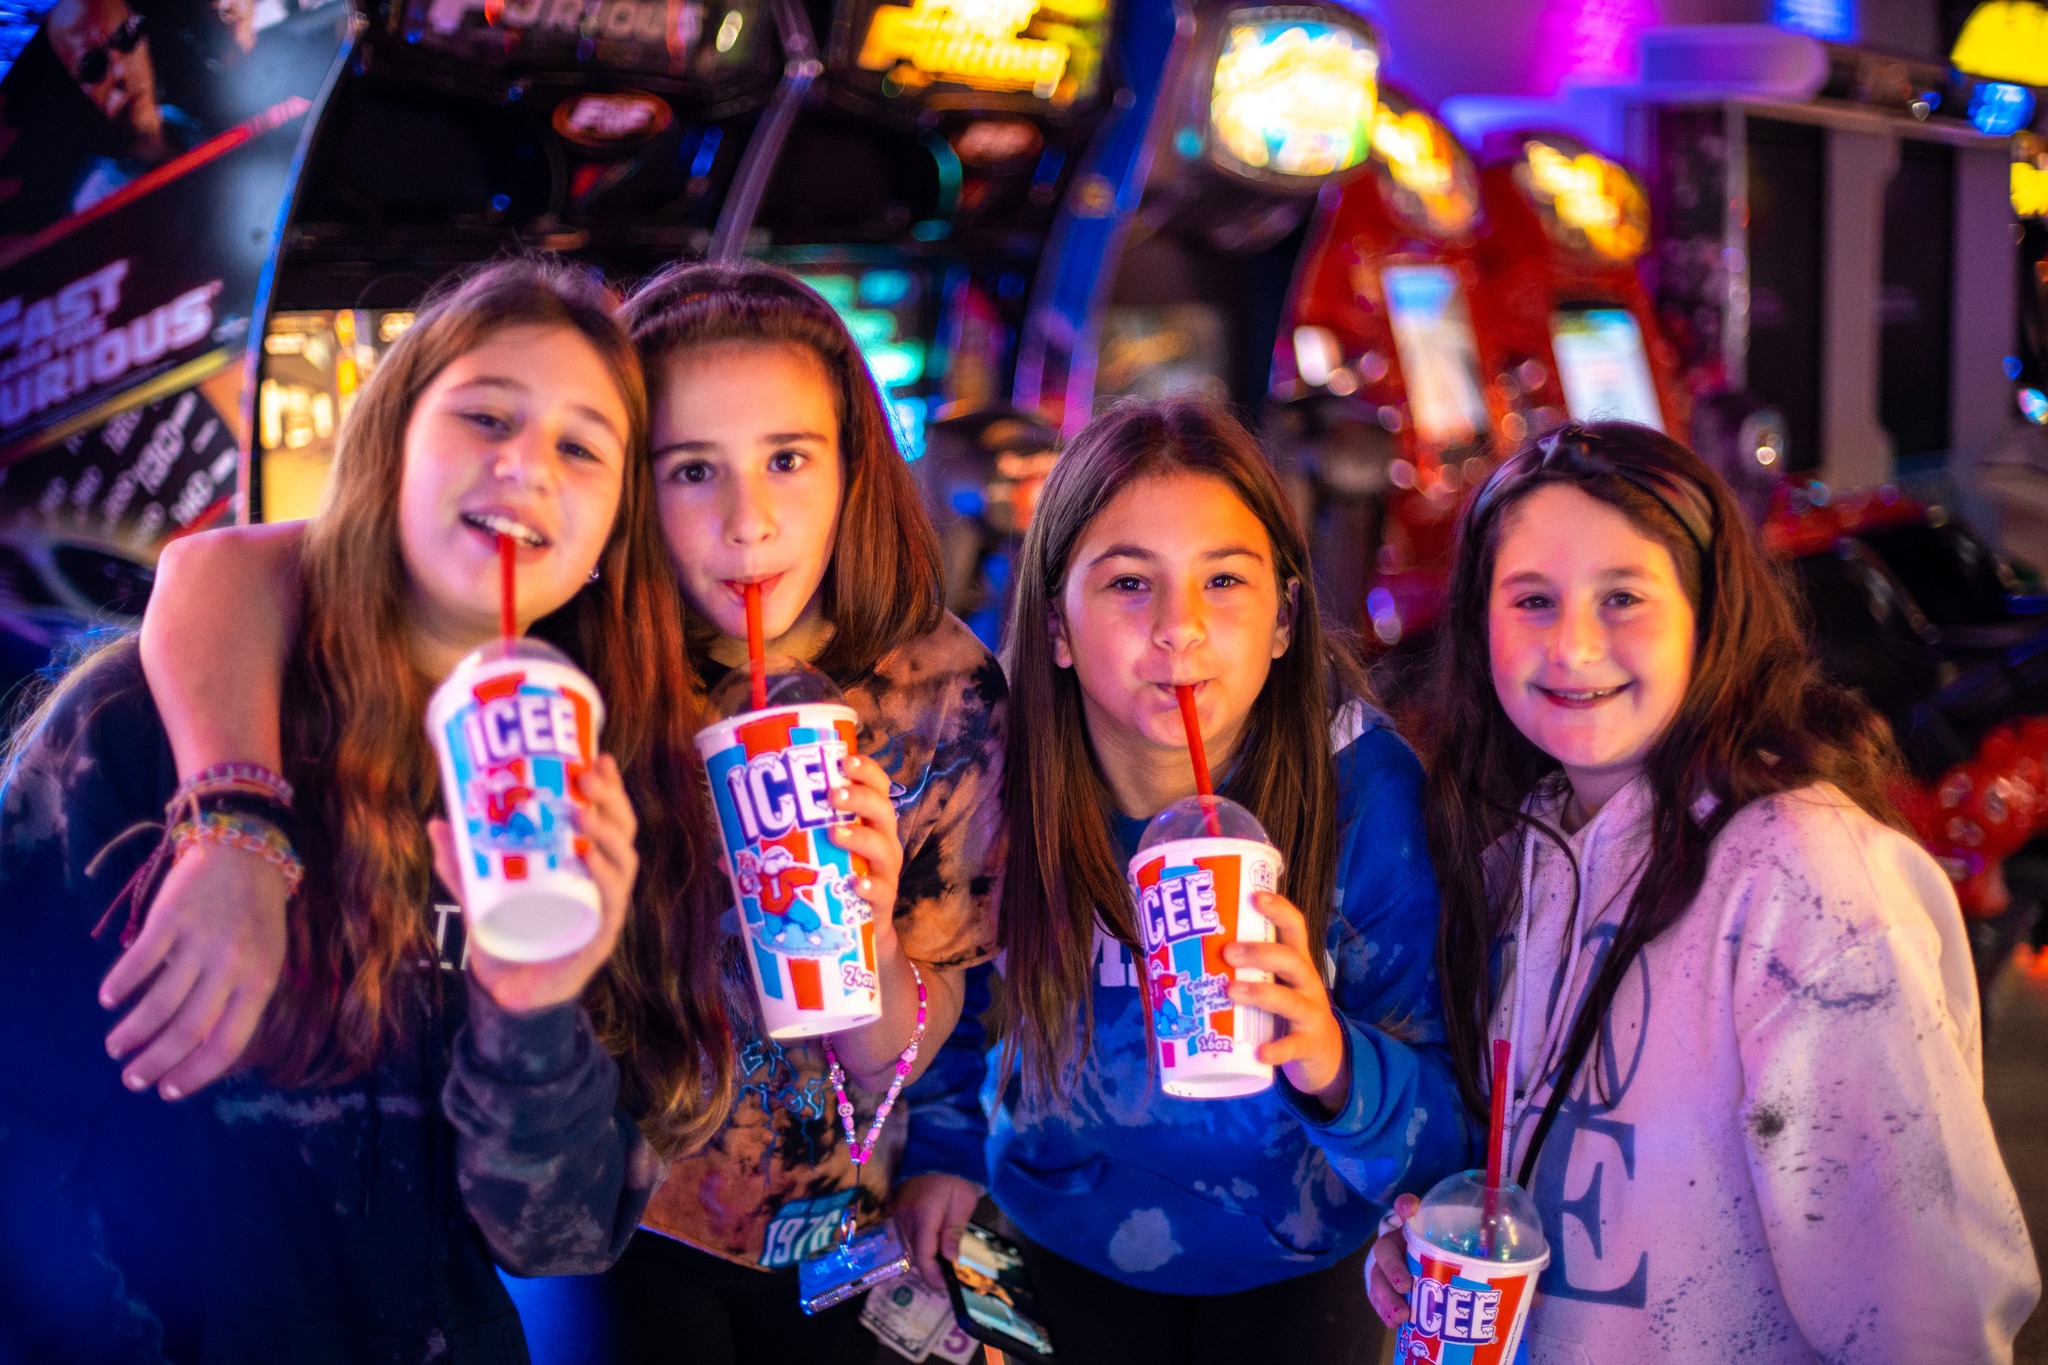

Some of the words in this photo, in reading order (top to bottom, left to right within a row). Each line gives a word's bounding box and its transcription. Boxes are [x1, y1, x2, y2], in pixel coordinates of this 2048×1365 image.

[0, 281, 214, 427] URIOUS
[464, 695, 581, 770] ICEE
[1186, 975, 1229, 993] Coldest
[1206, 999, 1232, 1011] Town
[761, 1206, 842, 1267] 1976
[1409, 1273, 1501, 1345] ICEE
